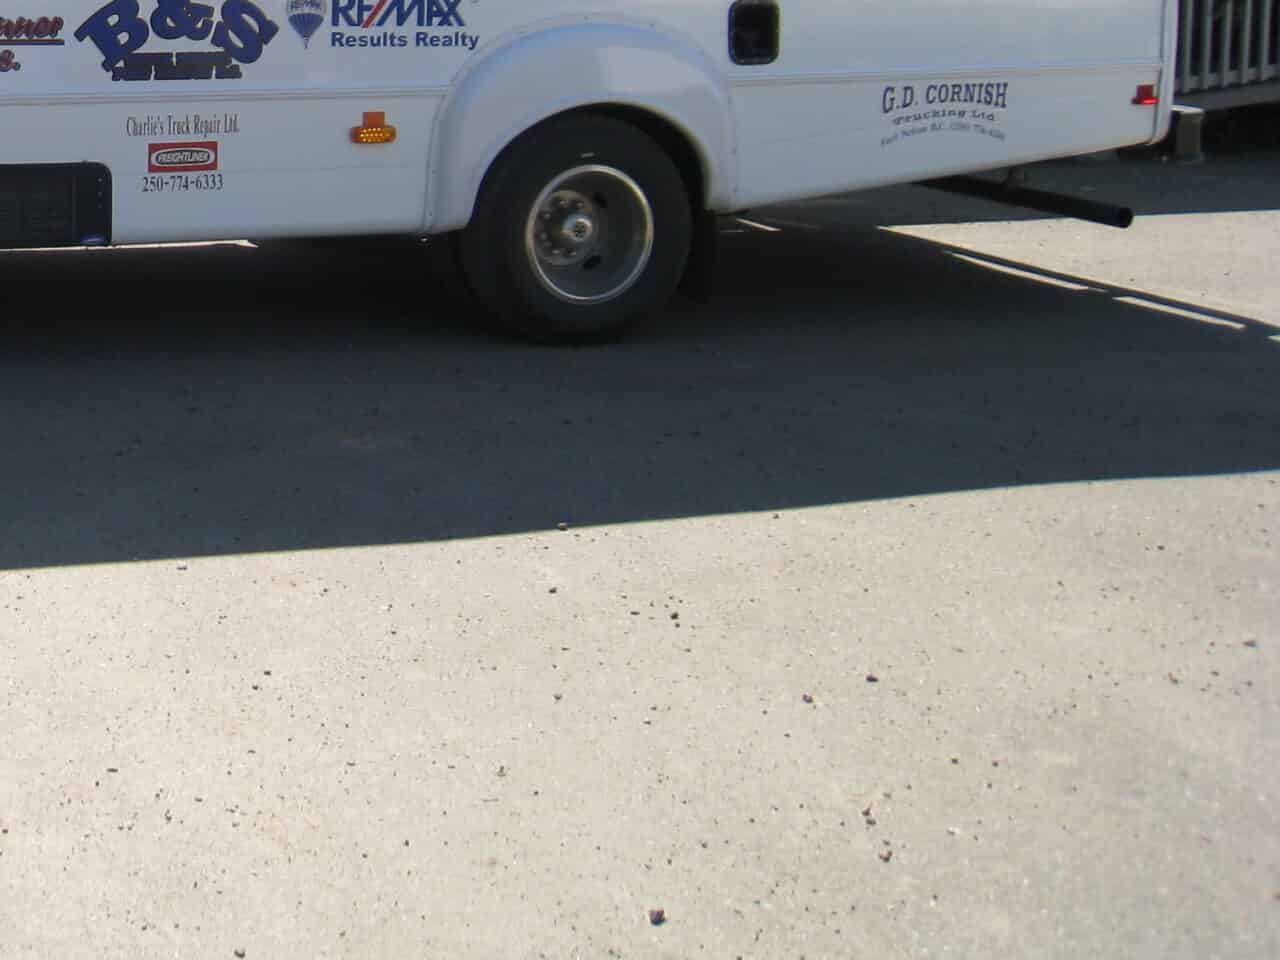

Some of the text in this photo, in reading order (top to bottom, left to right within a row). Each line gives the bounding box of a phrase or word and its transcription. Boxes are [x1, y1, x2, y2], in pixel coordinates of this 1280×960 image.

[331, 31, 480, 50] Results Realty
[882, 82, 1008, 114] G.D. CORNISH
[126, 115, 164, 136] Charlie's
[168, 114, 191, 135] Truck
[194, 114, 221, 137] Repair
[142, 174, 224, 192] 250-774-6333
